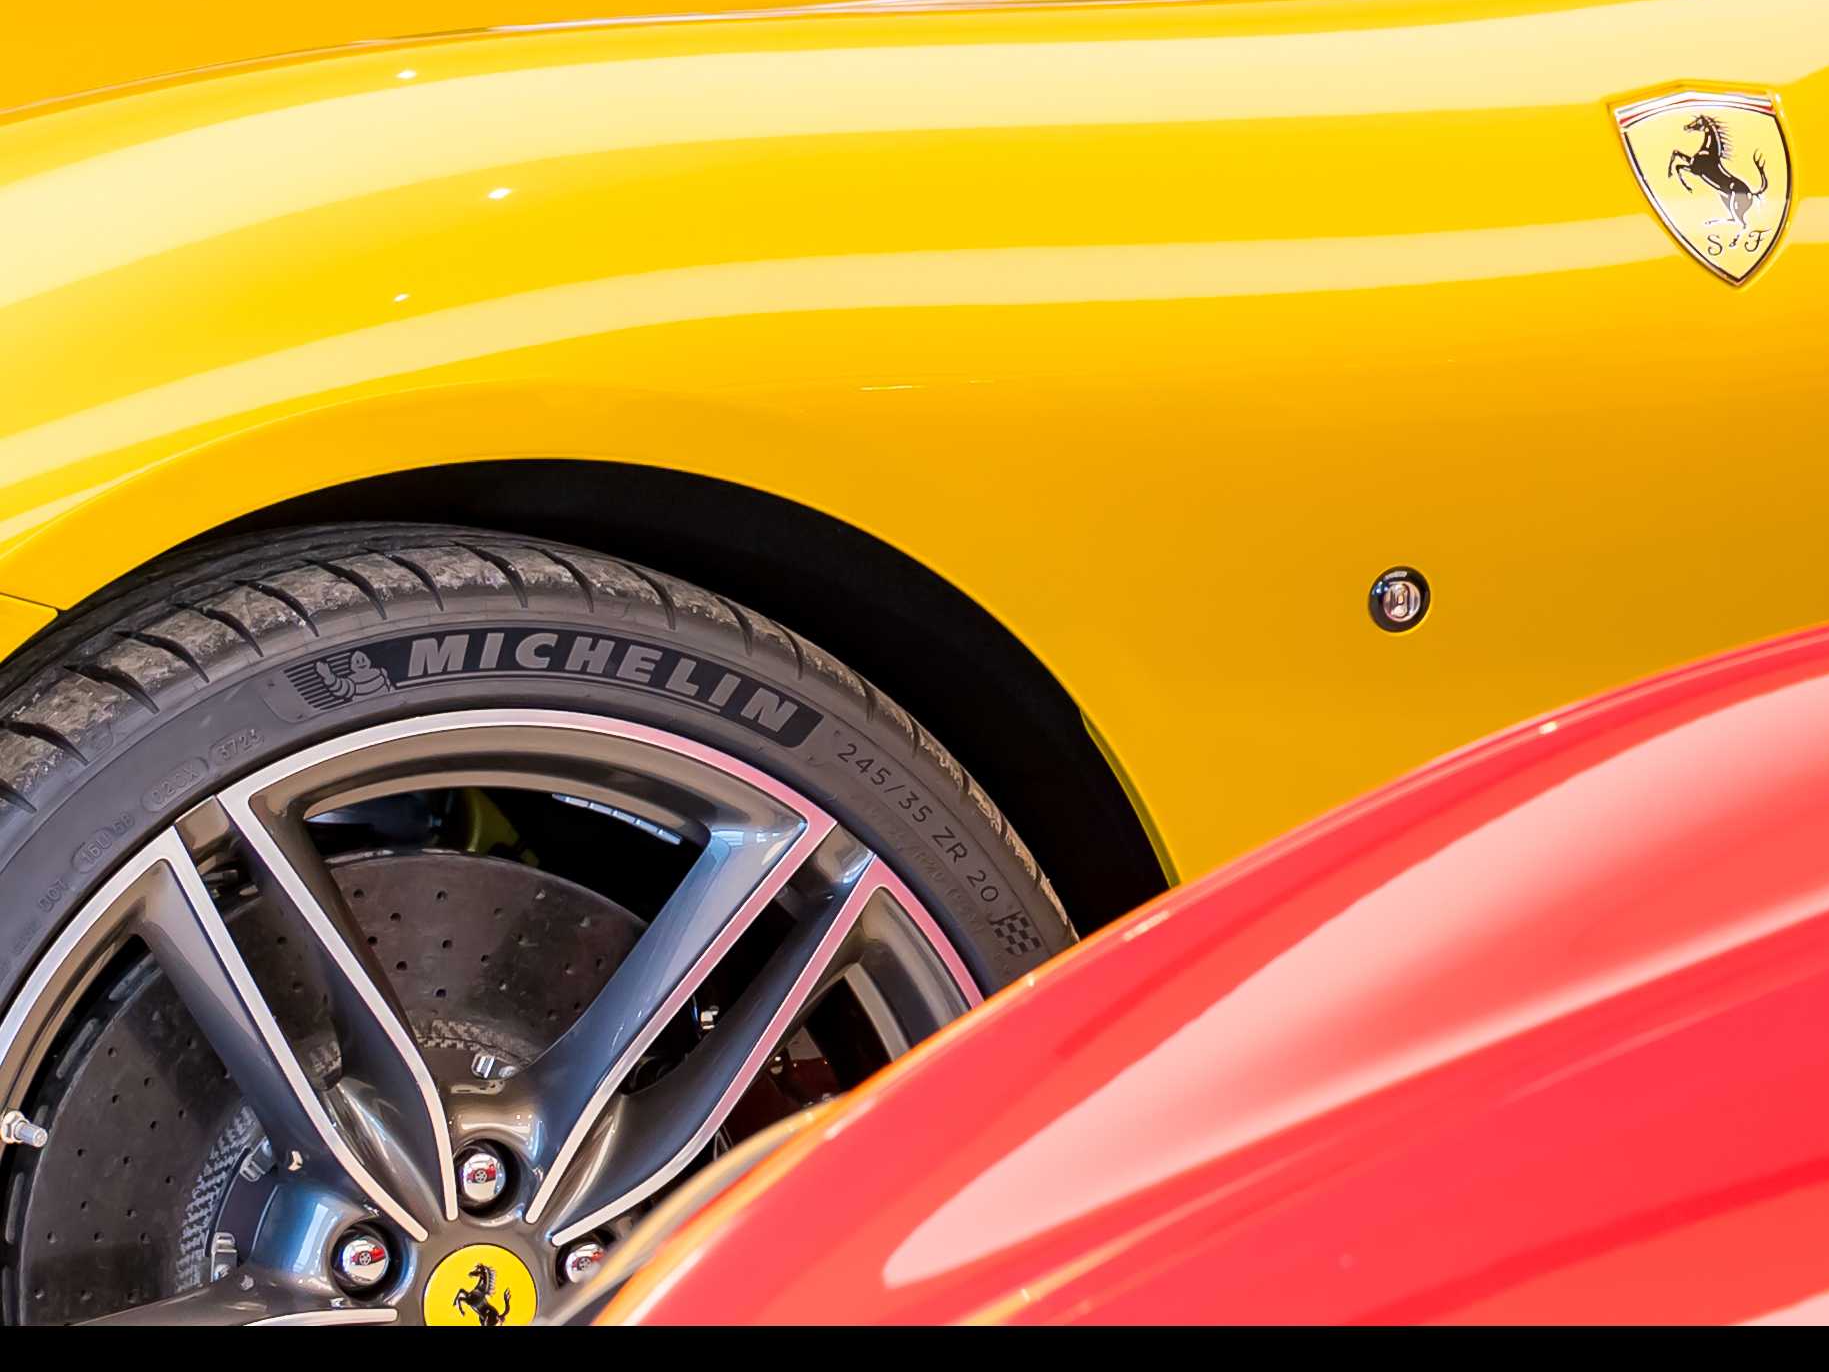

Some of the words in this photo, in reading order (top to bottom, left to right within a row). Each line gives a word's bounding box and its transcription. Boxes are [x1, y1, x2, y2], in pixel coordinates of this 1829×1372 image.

[1707, 234, 1723, 256] S
[407, 632, 799, 733] MICHELIN
[837, 743, 933, 823] 245/35
[932, 826, 968, 863] ZR
[966, 869, 999, 903] 20
